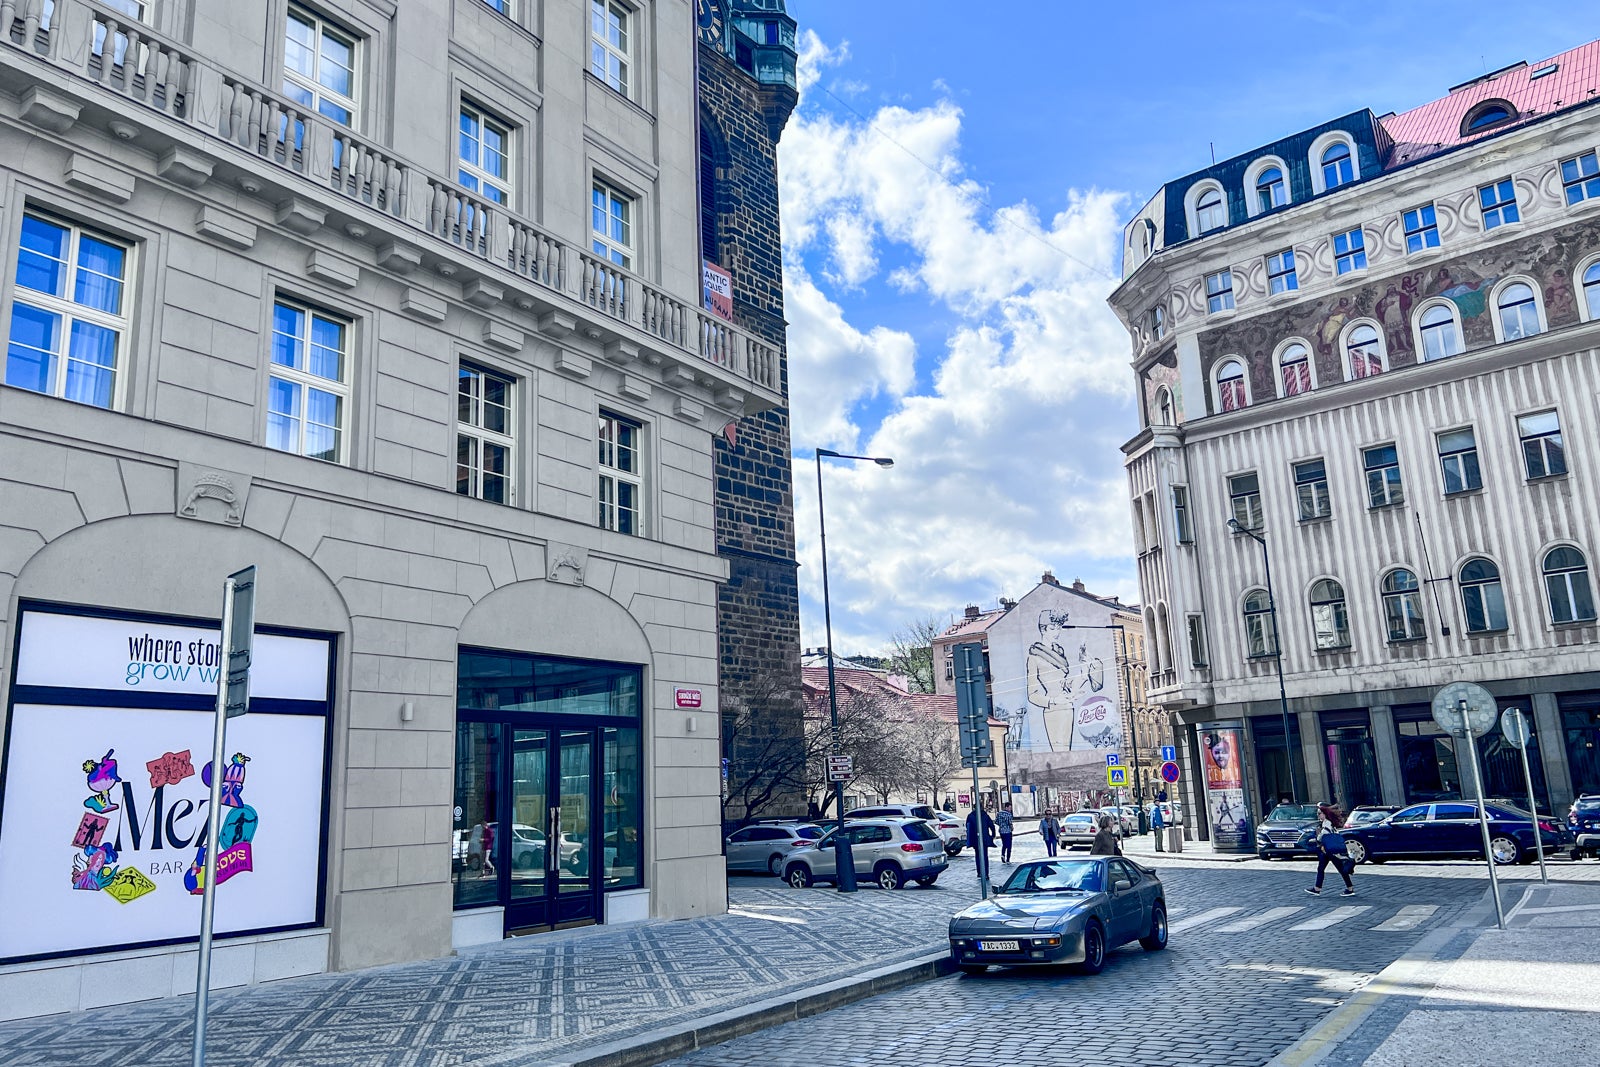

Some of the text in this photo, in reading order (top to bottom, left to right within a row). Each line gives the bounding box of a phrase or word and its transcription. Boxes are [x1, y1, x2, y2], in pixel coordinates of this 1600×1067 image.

[128, 633, 182, 664] where
[125, 662, 191, 686] grow
[150, 860, 183, 876] BAR
